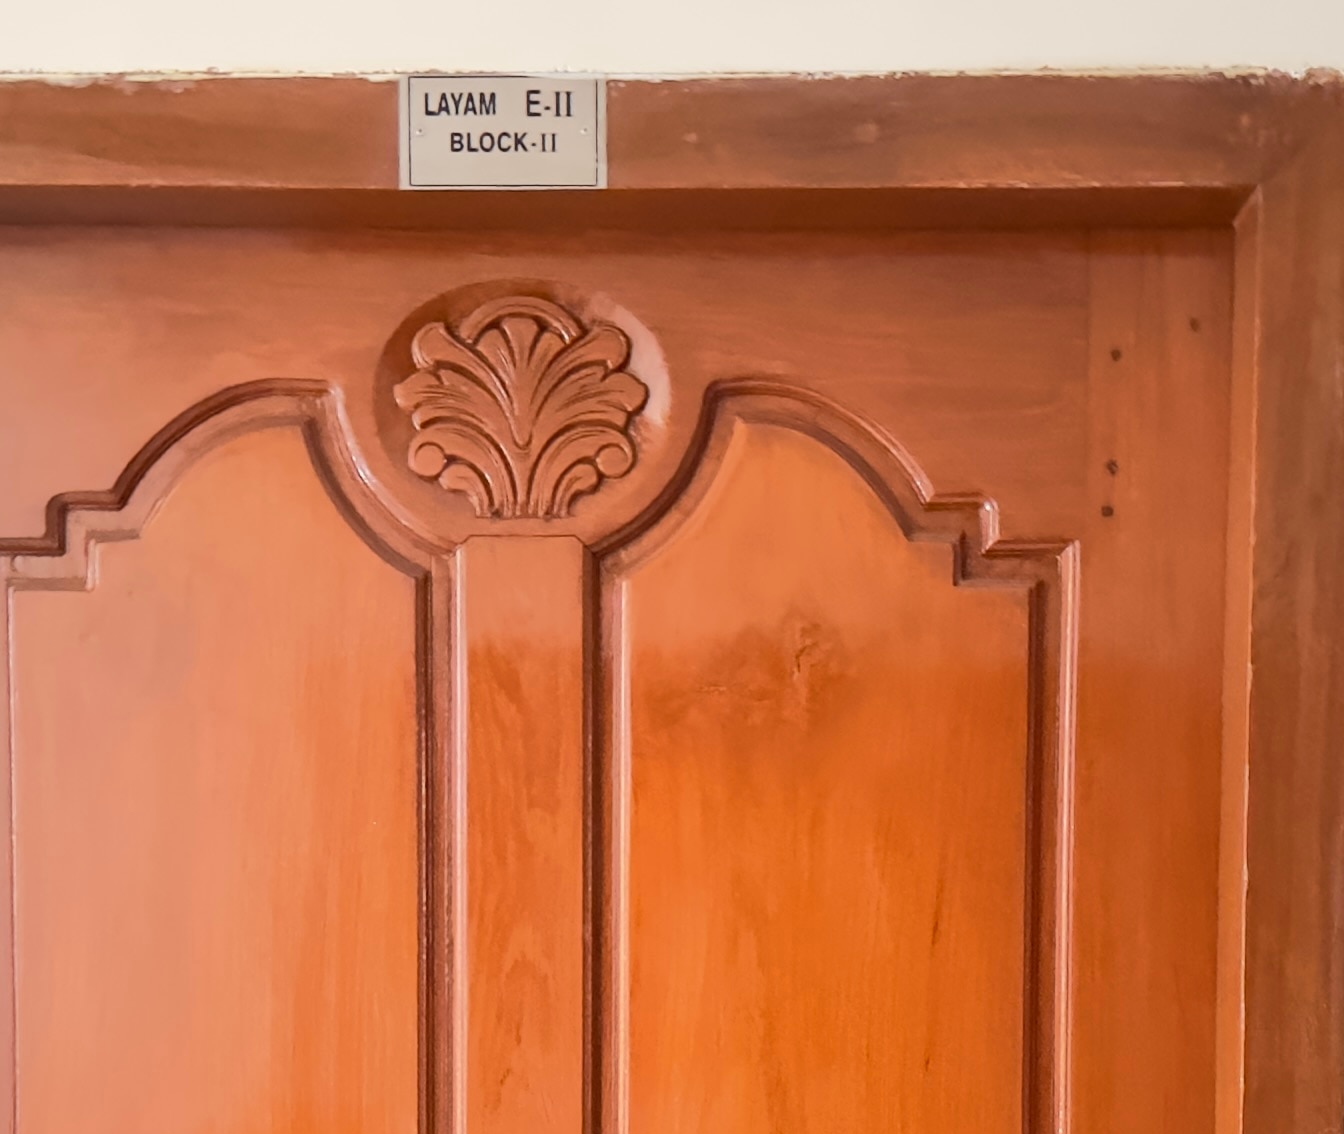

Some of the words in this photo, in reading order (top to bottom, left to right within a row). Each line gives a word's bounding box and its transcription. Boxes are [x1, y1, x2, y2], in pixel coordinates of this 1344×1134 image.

[423, 91, 497, 117] LAYAM
[525, 89, 573, 118] E-II
[449, 131, 557, 153] BLOCK-II
